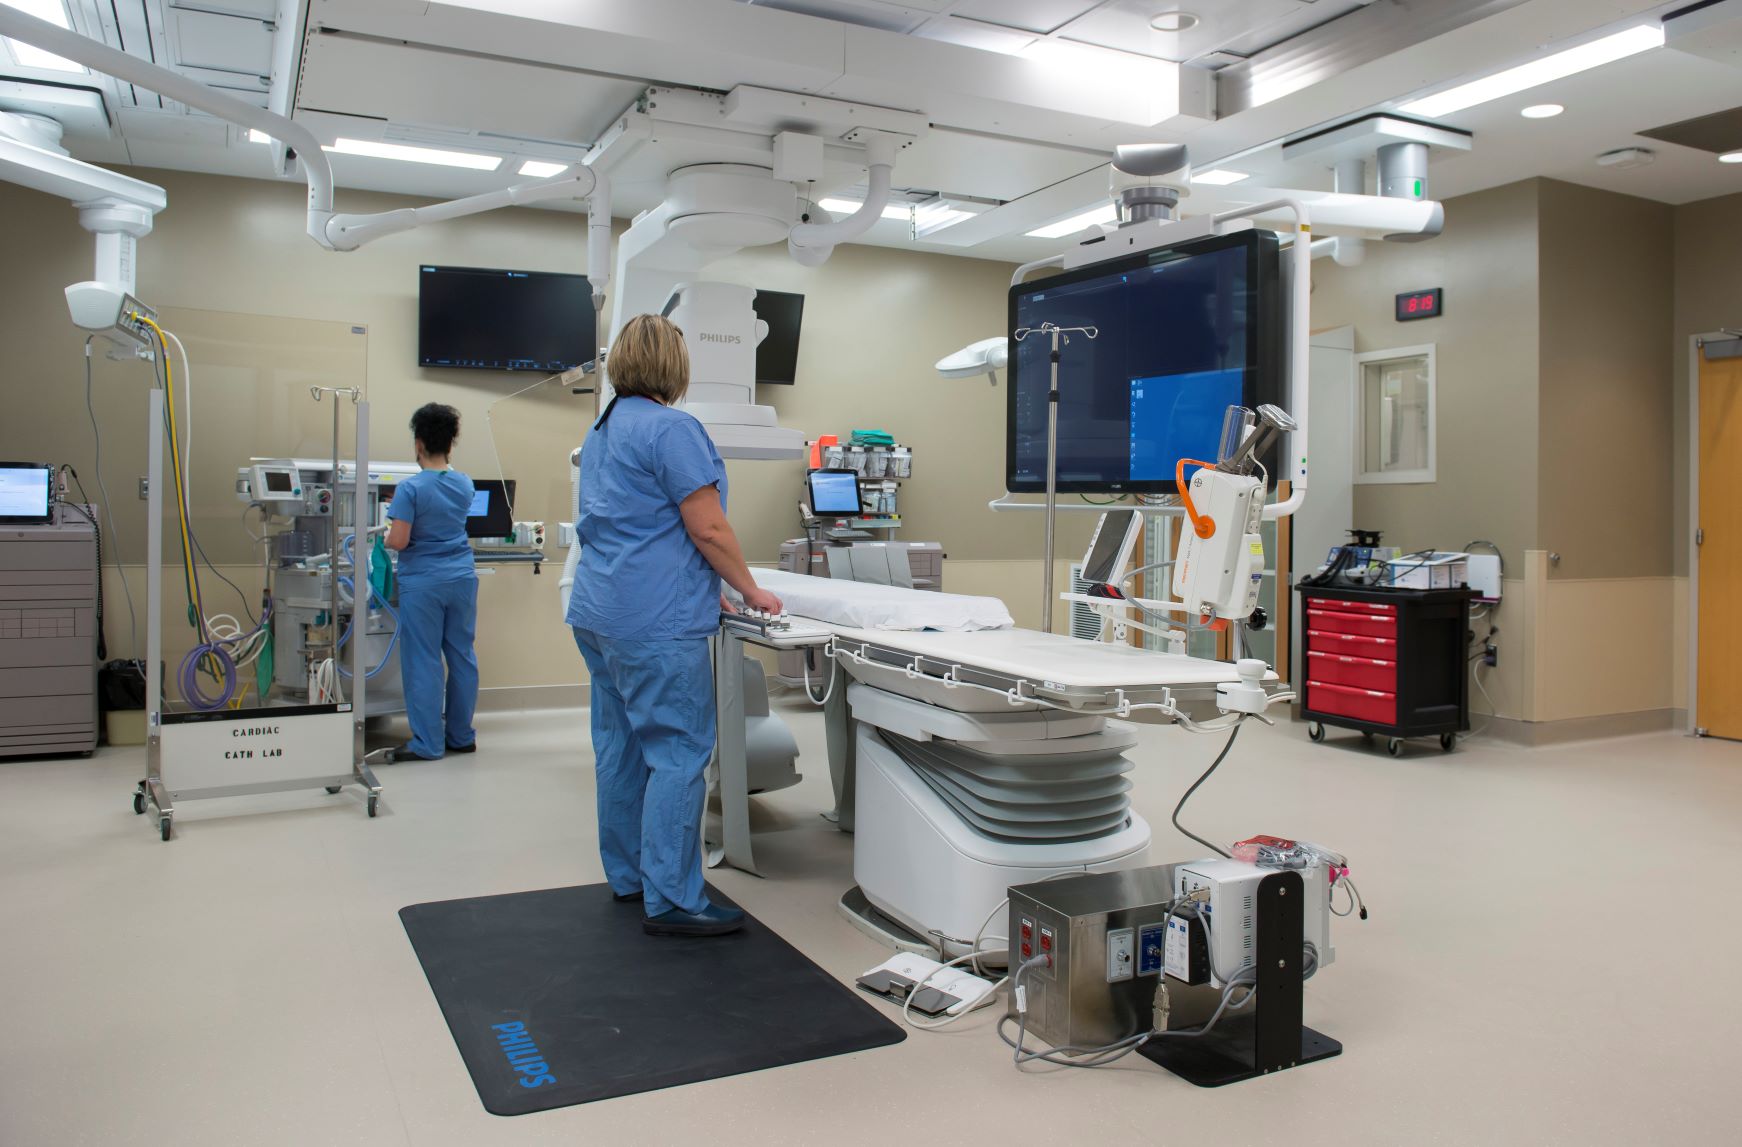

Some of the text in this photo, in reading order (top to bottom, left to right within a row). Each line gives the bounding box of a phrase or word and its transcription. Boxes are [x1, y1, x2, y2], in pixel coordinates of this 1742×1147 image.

[700, 332, 741, 345] PHILIPS
[232, 726, 281, 737] CARDIAC
[225, 748, 283, 760] CATH LAB
[491, 1020, 557, 1089] PHILIPS
